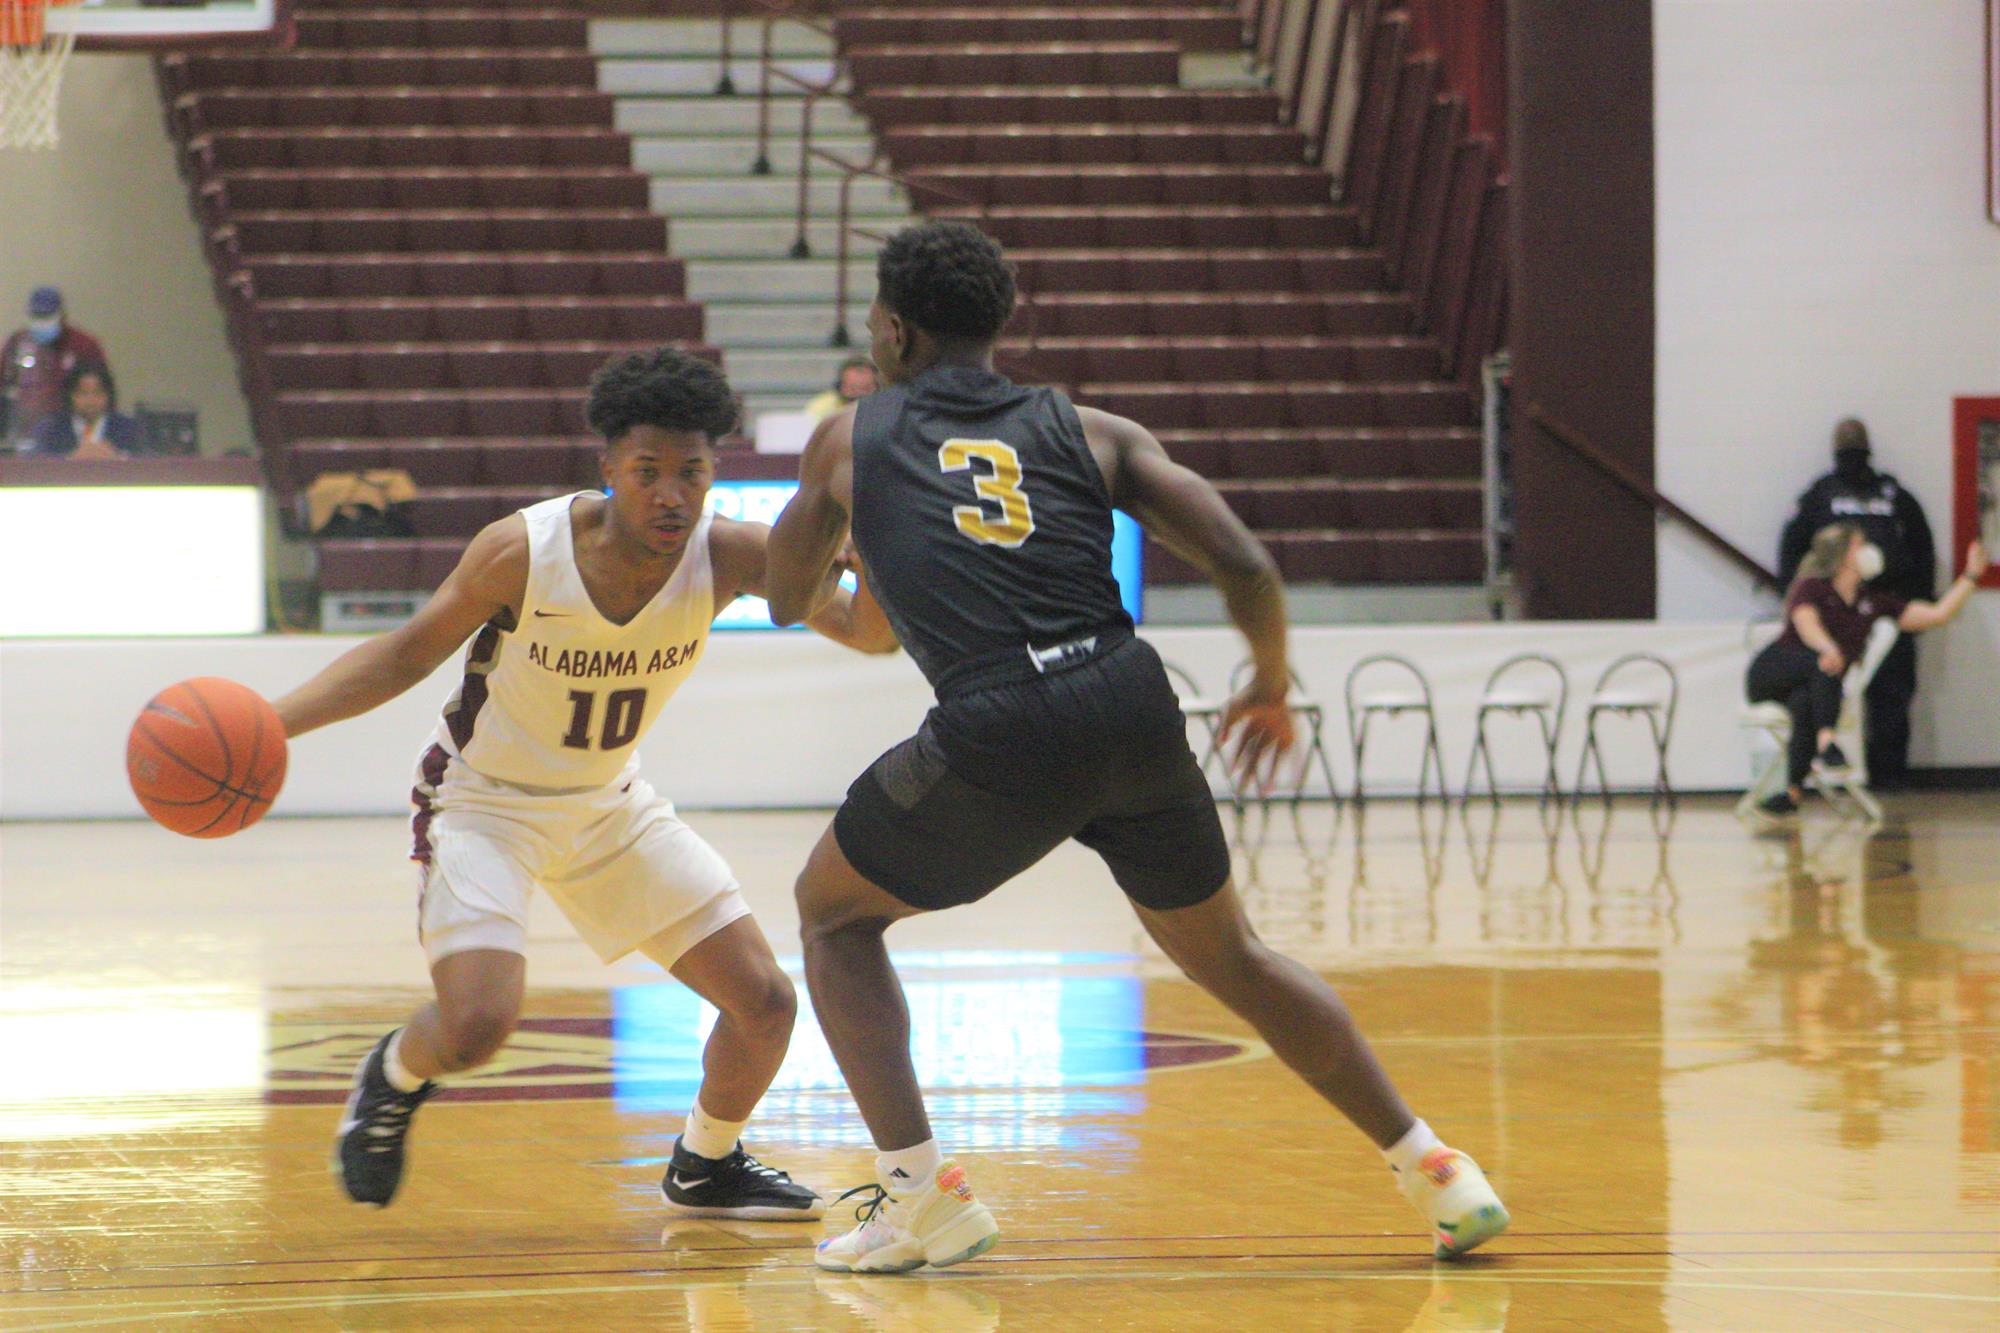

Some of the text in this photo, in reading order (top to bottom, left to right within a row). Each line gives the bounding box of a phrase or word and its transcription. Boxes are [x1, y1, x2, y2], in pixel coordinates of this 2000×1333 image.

[938, 438, 1036, 548] 3
[529, 639, 698, 678] ALABAMA A&M
[562, 687, 647, 751] 10
